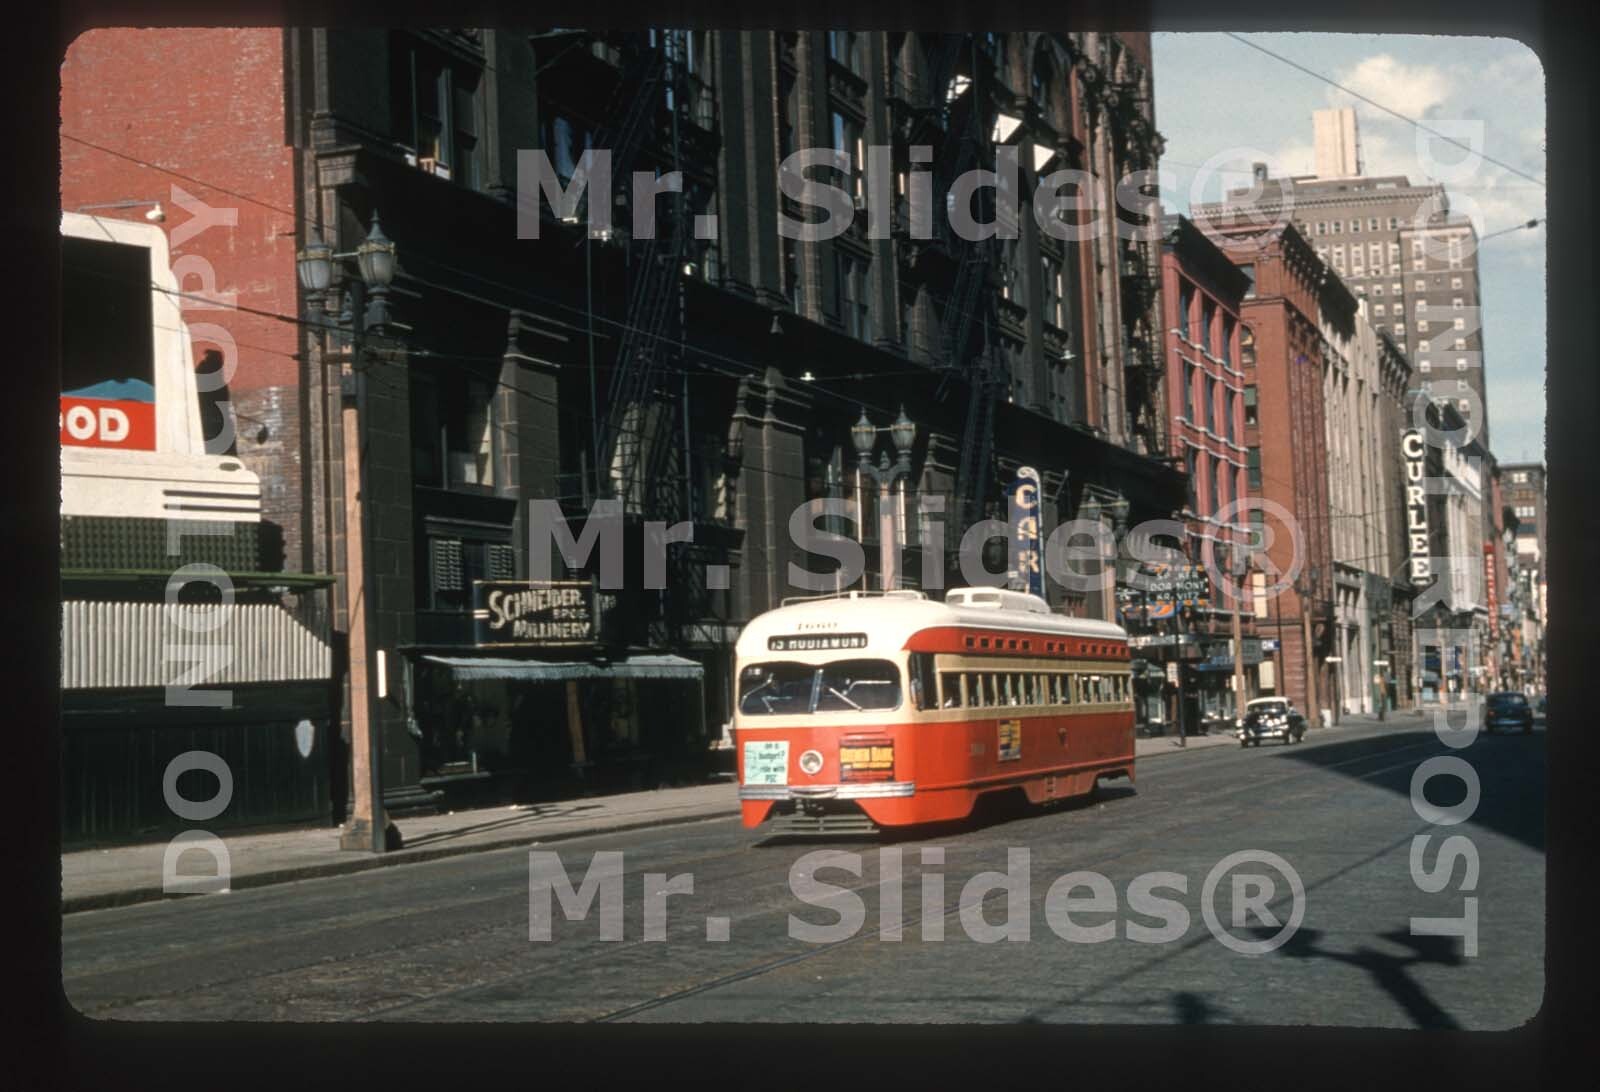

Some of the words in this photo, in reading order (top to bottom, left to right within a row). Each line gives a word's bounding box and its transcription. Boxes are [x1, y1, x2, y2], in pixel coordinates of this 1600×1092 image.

[59, 405, 129, 442] OD
[1016, 484, 1039, 595] CAR
[1403, 434, 1431, 577] CURLEE
